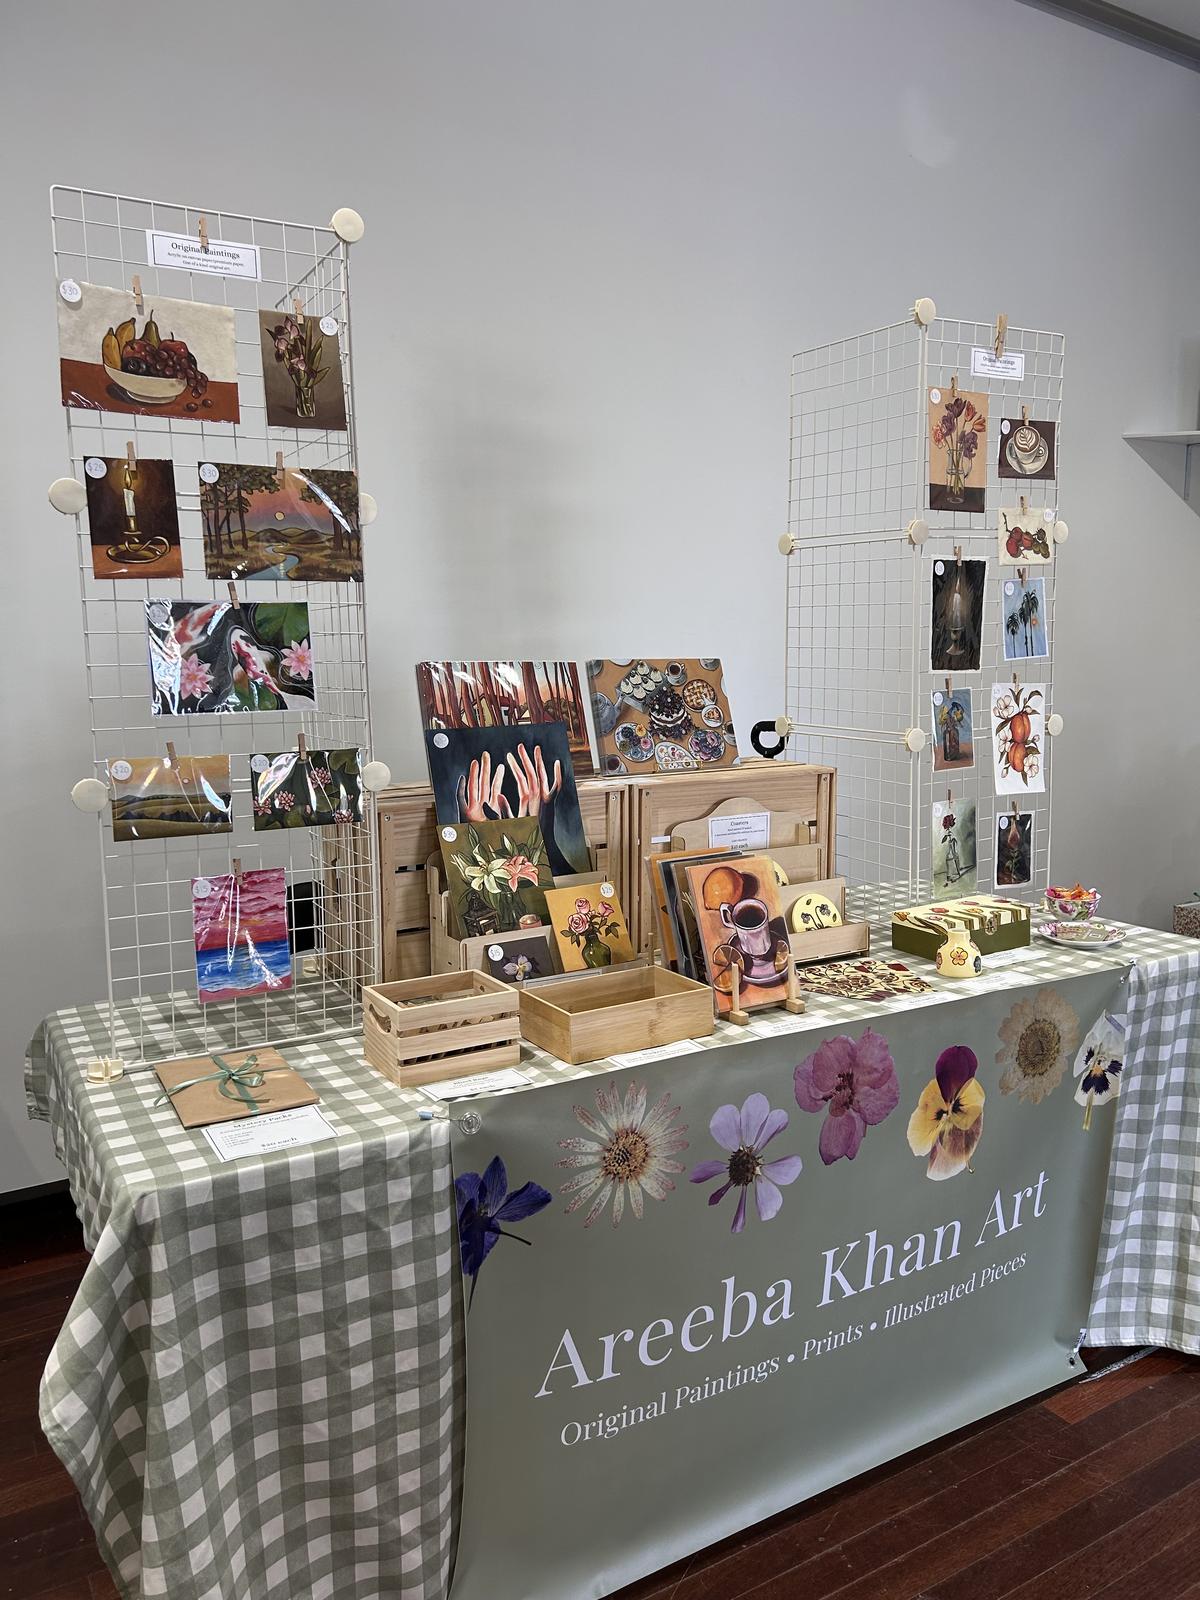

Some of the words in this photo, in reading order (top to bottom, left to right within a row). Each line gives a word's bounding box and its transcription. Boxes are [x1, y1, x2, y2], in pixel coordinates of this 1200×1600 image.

[171, 242, 202, 254] Original
[204, 247, 240, 260] Paintings
[62, 284, 78, 296] $30
[88, 462, 104, 472] $25
[202, 468, 216, 477] $30
[534, 1275, 796, 1398] Areeba
[816, 1219, 962, 1308] Khan
[974, 1170, 1050, 1248] Art
[560, 1391, 668, 1446] Original
[674, 1356, 780, 1410] Paintings
[802, 1323, 864, 1361] Prints
[884, 1272, 976, 1329] Illustrated
[980, 1251, 1028, 1288] Pieces
